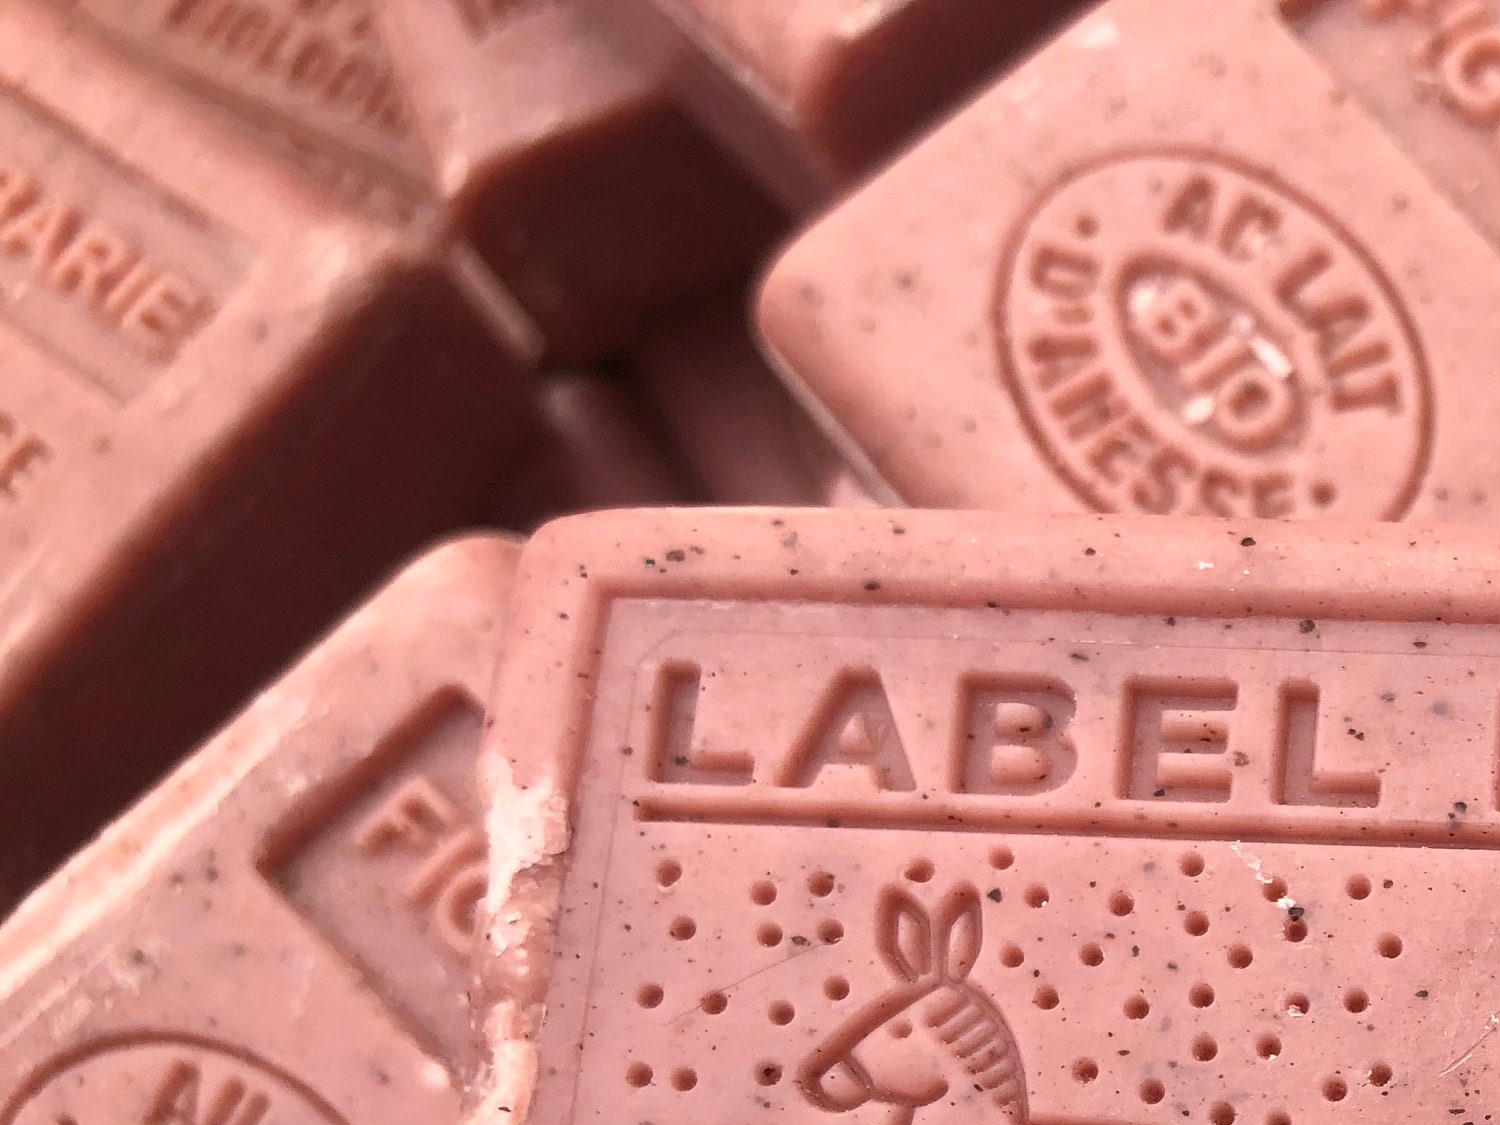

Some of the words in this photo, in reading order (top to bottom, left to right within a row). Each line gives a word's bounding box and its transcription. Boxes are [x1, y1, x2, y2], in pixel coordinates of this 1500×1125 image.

[1128, 280, 1310, 455] BIO
[1276, 246, 1404, 417] LAIT
[644, 660, 1382, 808] LABEL
